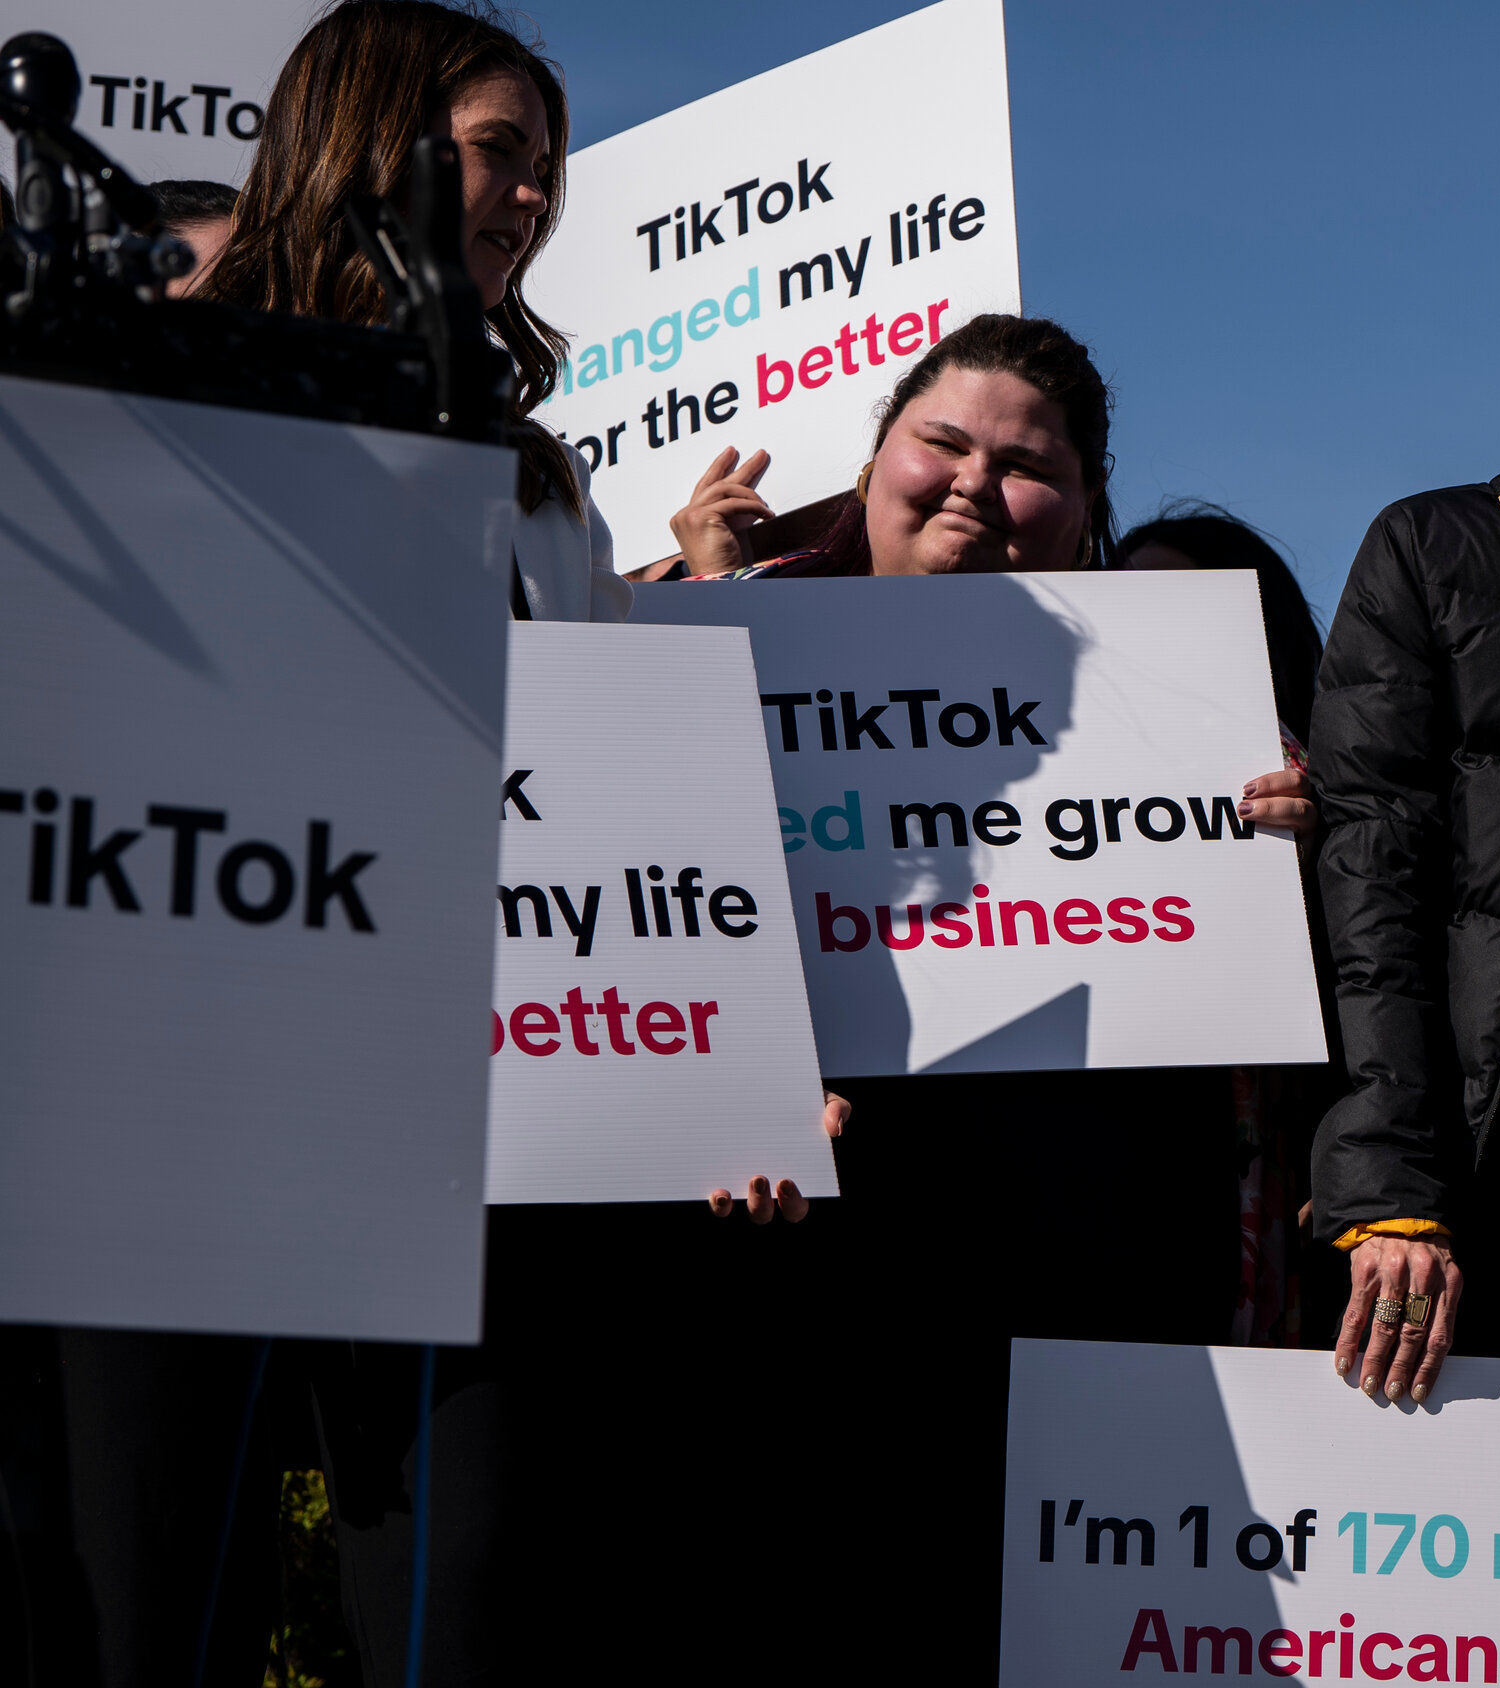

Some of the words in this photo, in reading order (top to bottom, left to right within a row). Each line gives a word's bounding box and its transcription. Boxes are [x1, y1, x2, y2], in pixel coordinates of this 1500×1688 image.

[89, 75, 266, 141] TikTo
[637, 158, 833, 272] TikTok
[778, 236, 871, 309] my
[889, 193, 985, 267] life
[641, 381, 739, 449] the
[756, 298, 949, 408] better
[760, 688, 1048, 752] TikTok
[889, 800, 1022, 849] me
[1045, 796, 1256, 861] grow
[624, 864, 758, 938] life
[815, 883, 1195, 953] business
[490, 986, 719, 1057] etter
[1038, 1498, 1156, 1567] I’m
[1178, 1504, 1210, 1569] 1
[1234, 1508, 1317, 1572] of
[1337, 1511, 1470, 1579] 170
